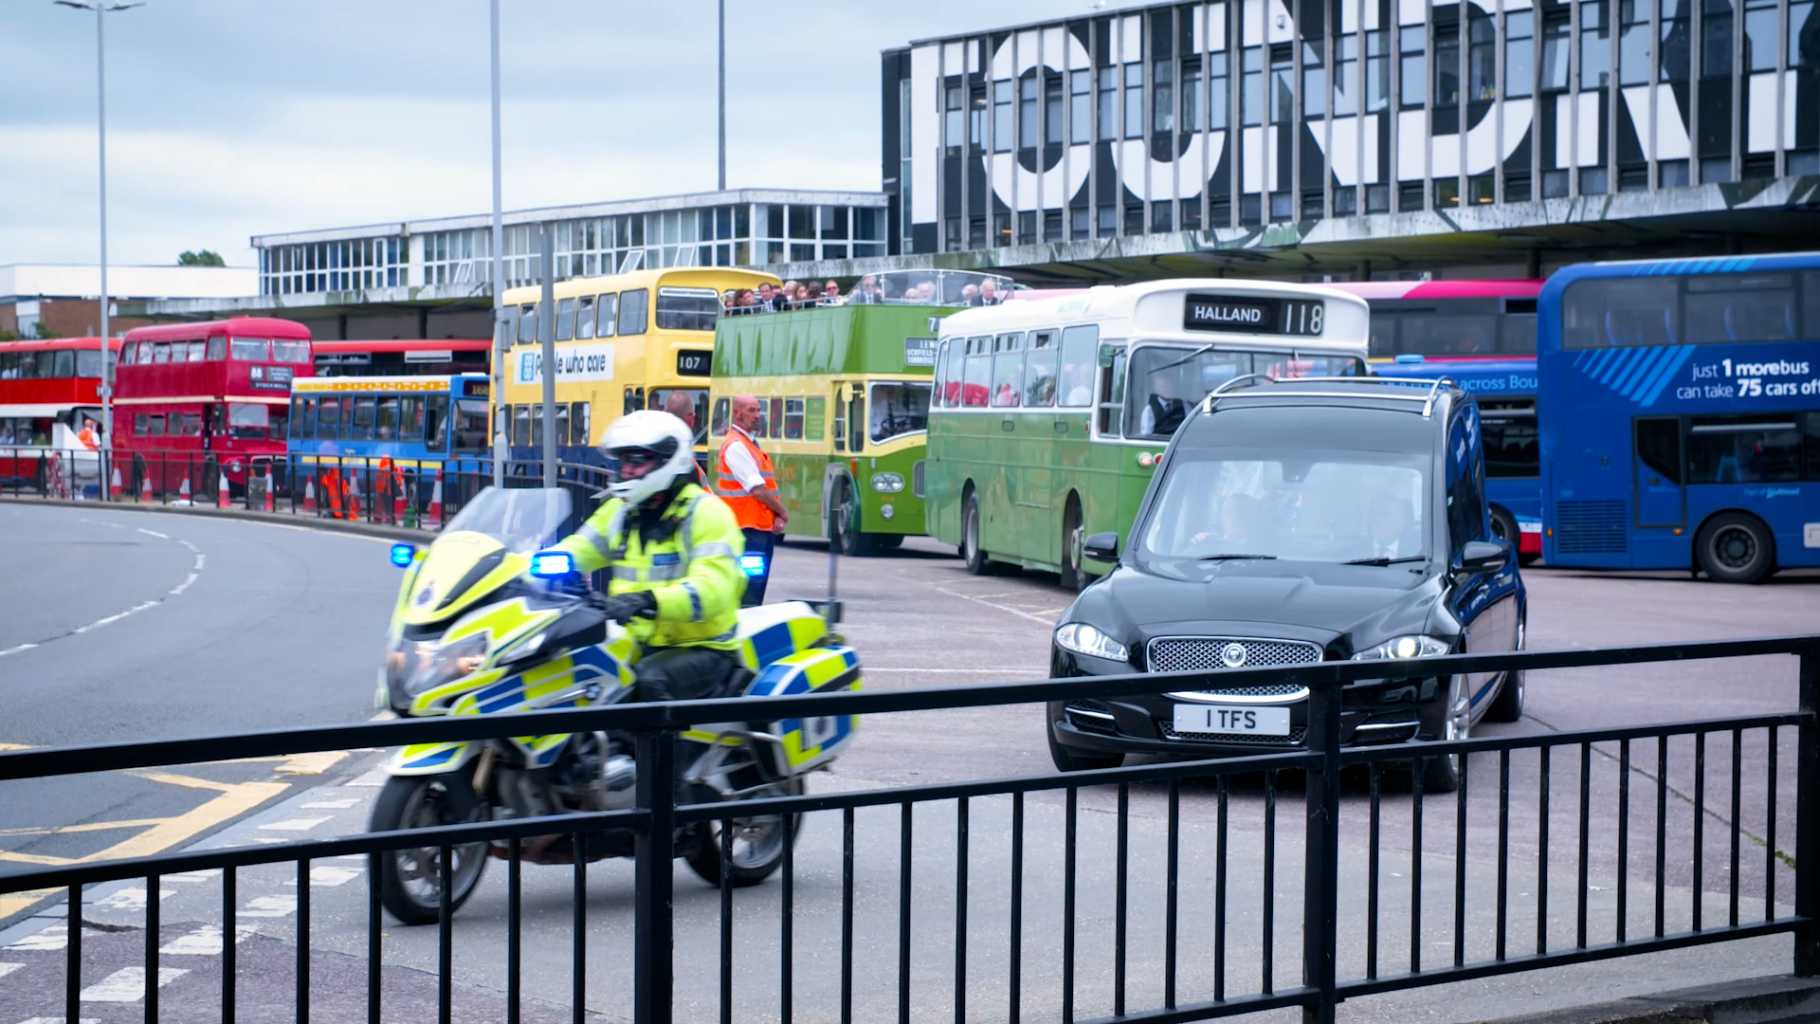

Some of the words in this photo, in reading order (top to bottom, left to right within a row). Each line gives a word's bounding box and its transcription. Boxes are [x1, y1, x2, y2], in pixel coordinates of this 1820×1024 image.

[1195, 305, 1262, 322] HALLAND
[1286, 303, 1323, 333] 118
[566, 349, 584, 373] who
[587, 354, 606, 373] care
[679, 356, 701, 369] 107
[1692, 363, 1719, 382] just
[1722, 358, 1732, 377] 1
[1736, 360, 1809, 376] morebus
[1460, 378, 1506, 391] across
[1676, 386, 1701, 400] can
[1704, 383, 1734, 398] take
[1737, 378, 1762, 397] 75
[1765, 381, 1798, 396] cars
[1217, 709, 1257, 729] TFS
